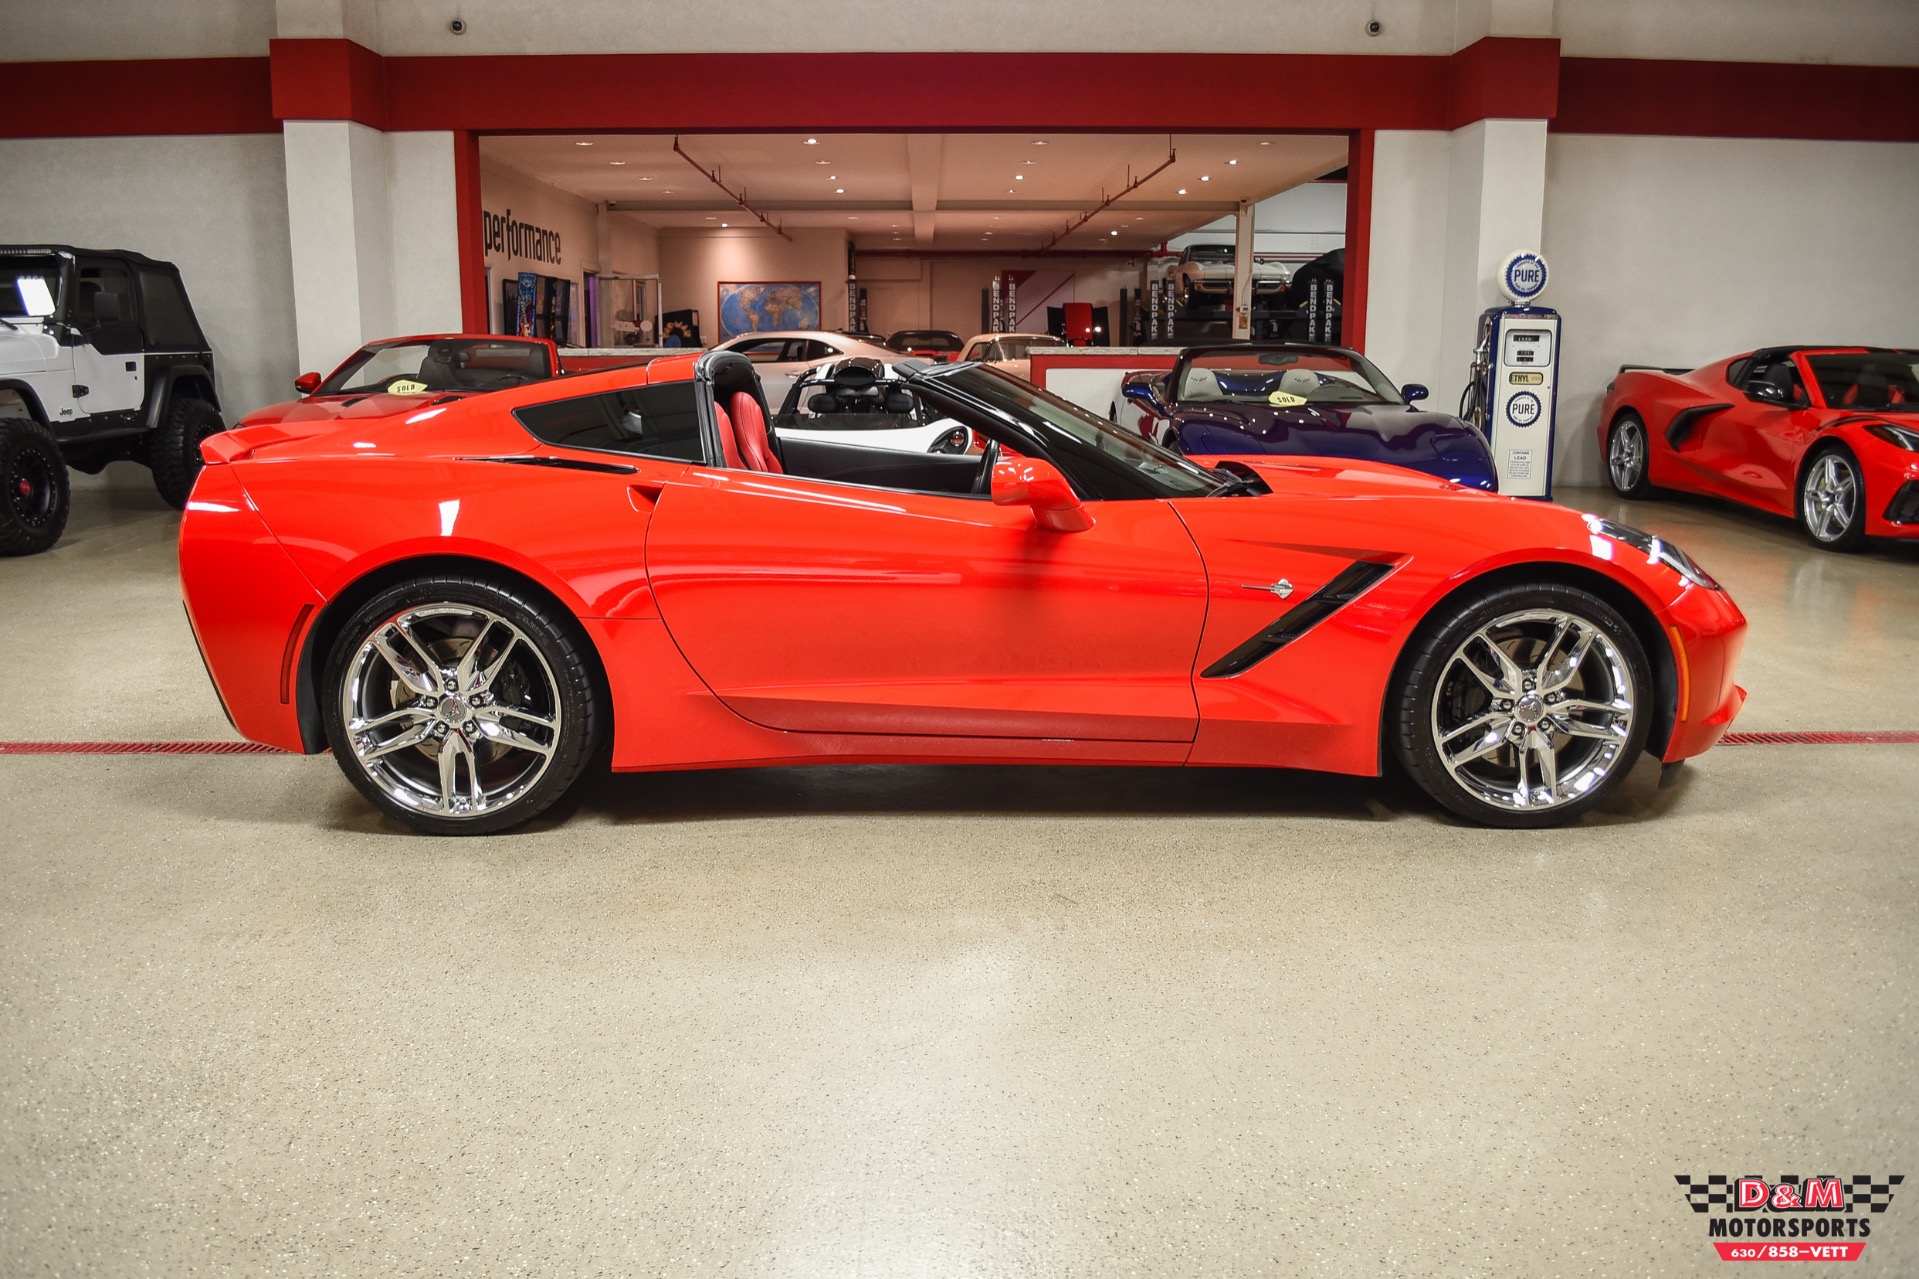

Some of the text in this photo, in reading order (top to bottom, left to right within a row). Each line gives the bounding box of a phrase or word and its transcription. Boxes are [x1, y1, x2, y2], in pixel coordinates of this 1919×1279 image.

[483, 208, 562, 265] performance
[1514, 269, 1540, 282] PURE
[992, 281, 1000, 332] BENDPAK
[1008, 283, 1016, 332] BENDPAK
[1151, 283, 1159, 332] BENDPAK
[1167, 283, 1175, 332] BENDPAK
[1309, 284, 1317, 333] BENDPAK
[1324, 284, 1333, 333] BENDPAK
[396, 384, 415, 393] SOLD
[1510, 374, 1529, 382] ETHYL
[59, 407, 73, 416] Jeep
[1512, 403, 1535, 415] PURE
